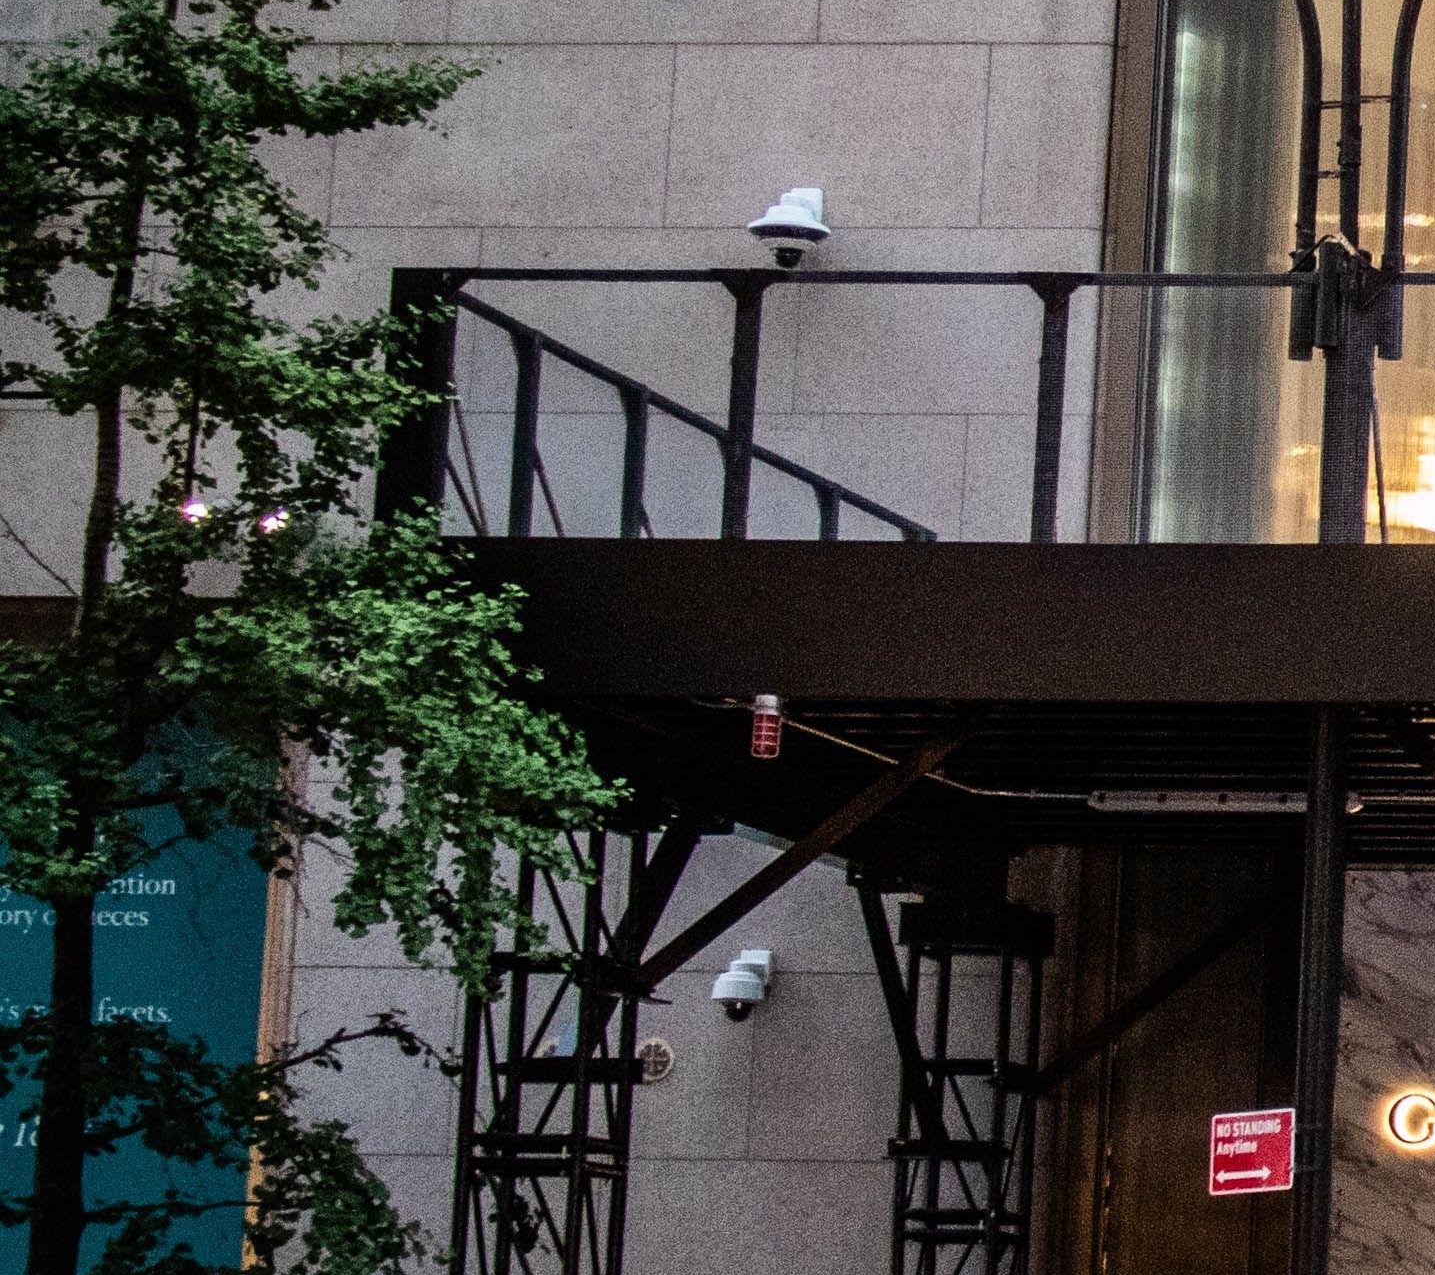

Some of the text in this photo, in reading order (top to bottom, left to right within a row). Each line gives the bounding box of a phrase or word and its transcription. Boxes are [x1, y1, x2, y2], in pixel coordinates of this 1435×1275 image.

[1216, 1118, 1281, 1139] NO STANDING
[1216, 1139, 1258, 1158] Anytime
